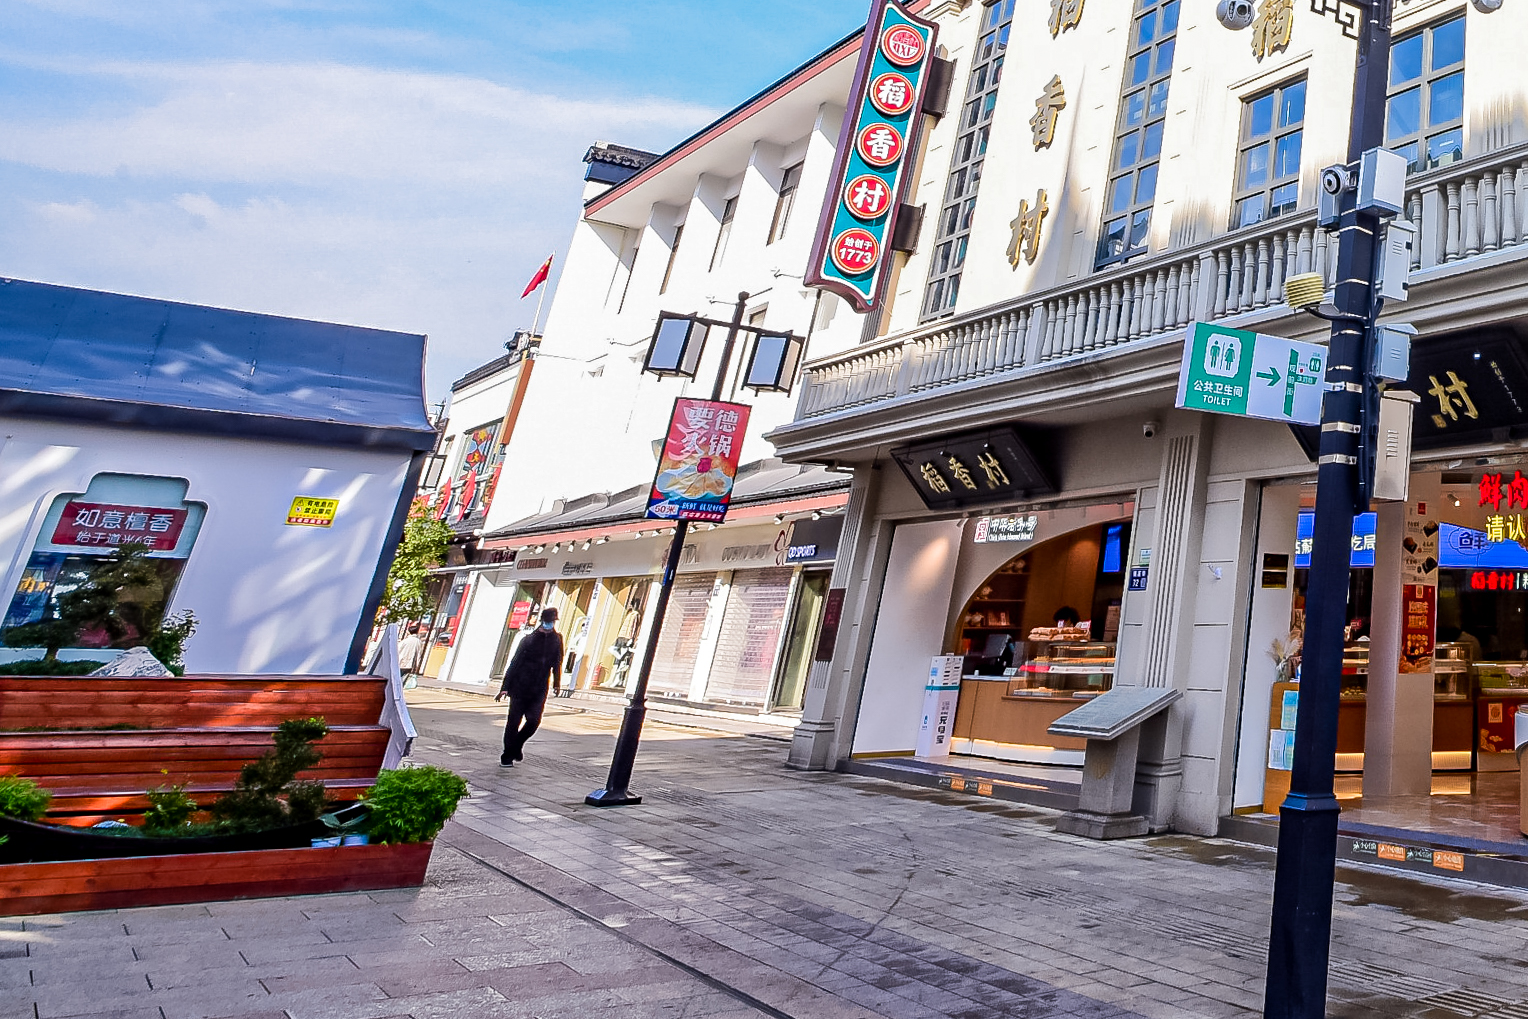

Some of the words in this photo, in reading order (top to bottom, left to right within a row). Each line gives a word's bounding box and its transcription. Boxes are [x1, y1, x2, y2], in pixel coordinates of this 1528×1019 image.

[854, 79, 907, 212] 稻香村
[844, 236, 873, 250] 始创于
[839, 247, 872, 264] 1773
[1193, 379, 1244, 398] 公共卫生间
[1202, 394, 1232, 407] TOILET
[921, 452, 1010, 494] 稻香村
[654, 504, 677, 514] 50米
[72, 508, 174, 533] 如意檀香
